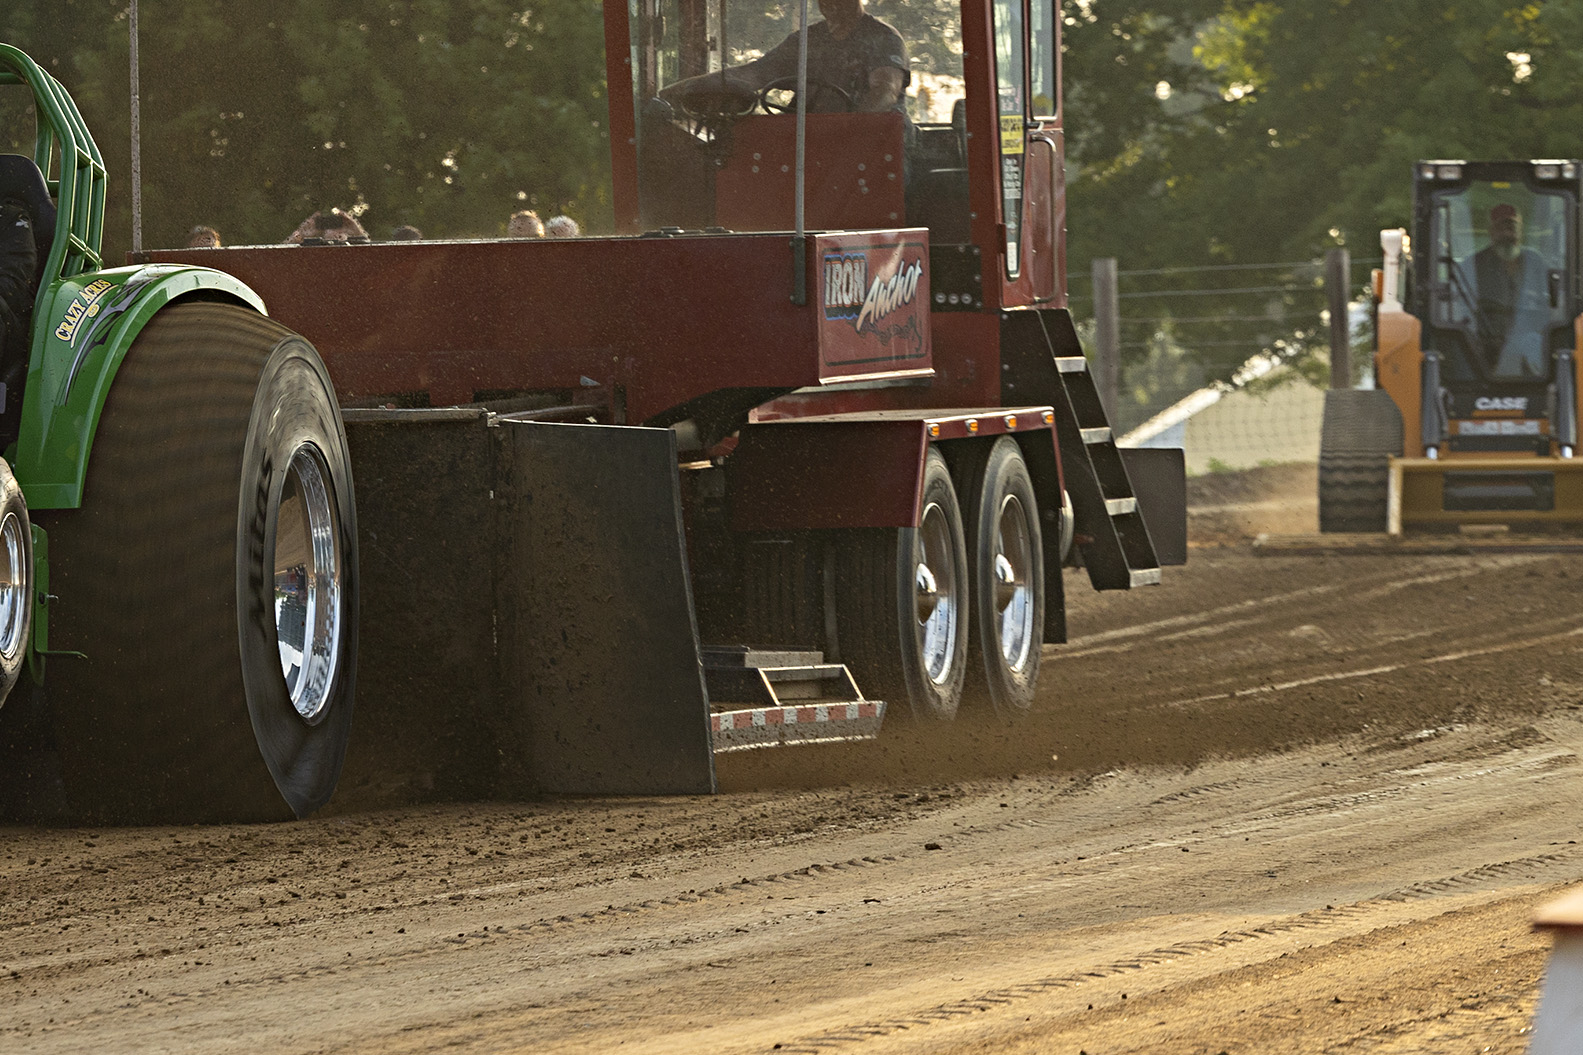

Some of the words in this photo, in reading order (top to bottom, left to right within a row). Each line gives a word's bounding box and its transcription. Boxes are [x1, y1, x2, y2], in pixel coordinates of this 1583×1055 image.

[55, 298, 87, 342] CRAZY
[78, 279, 113, 305] ACRES
[824, 256, 866, 310] IRON
[856, 257, 923, 333] Anchor
[1475, 397, 1528, 411] CASE
